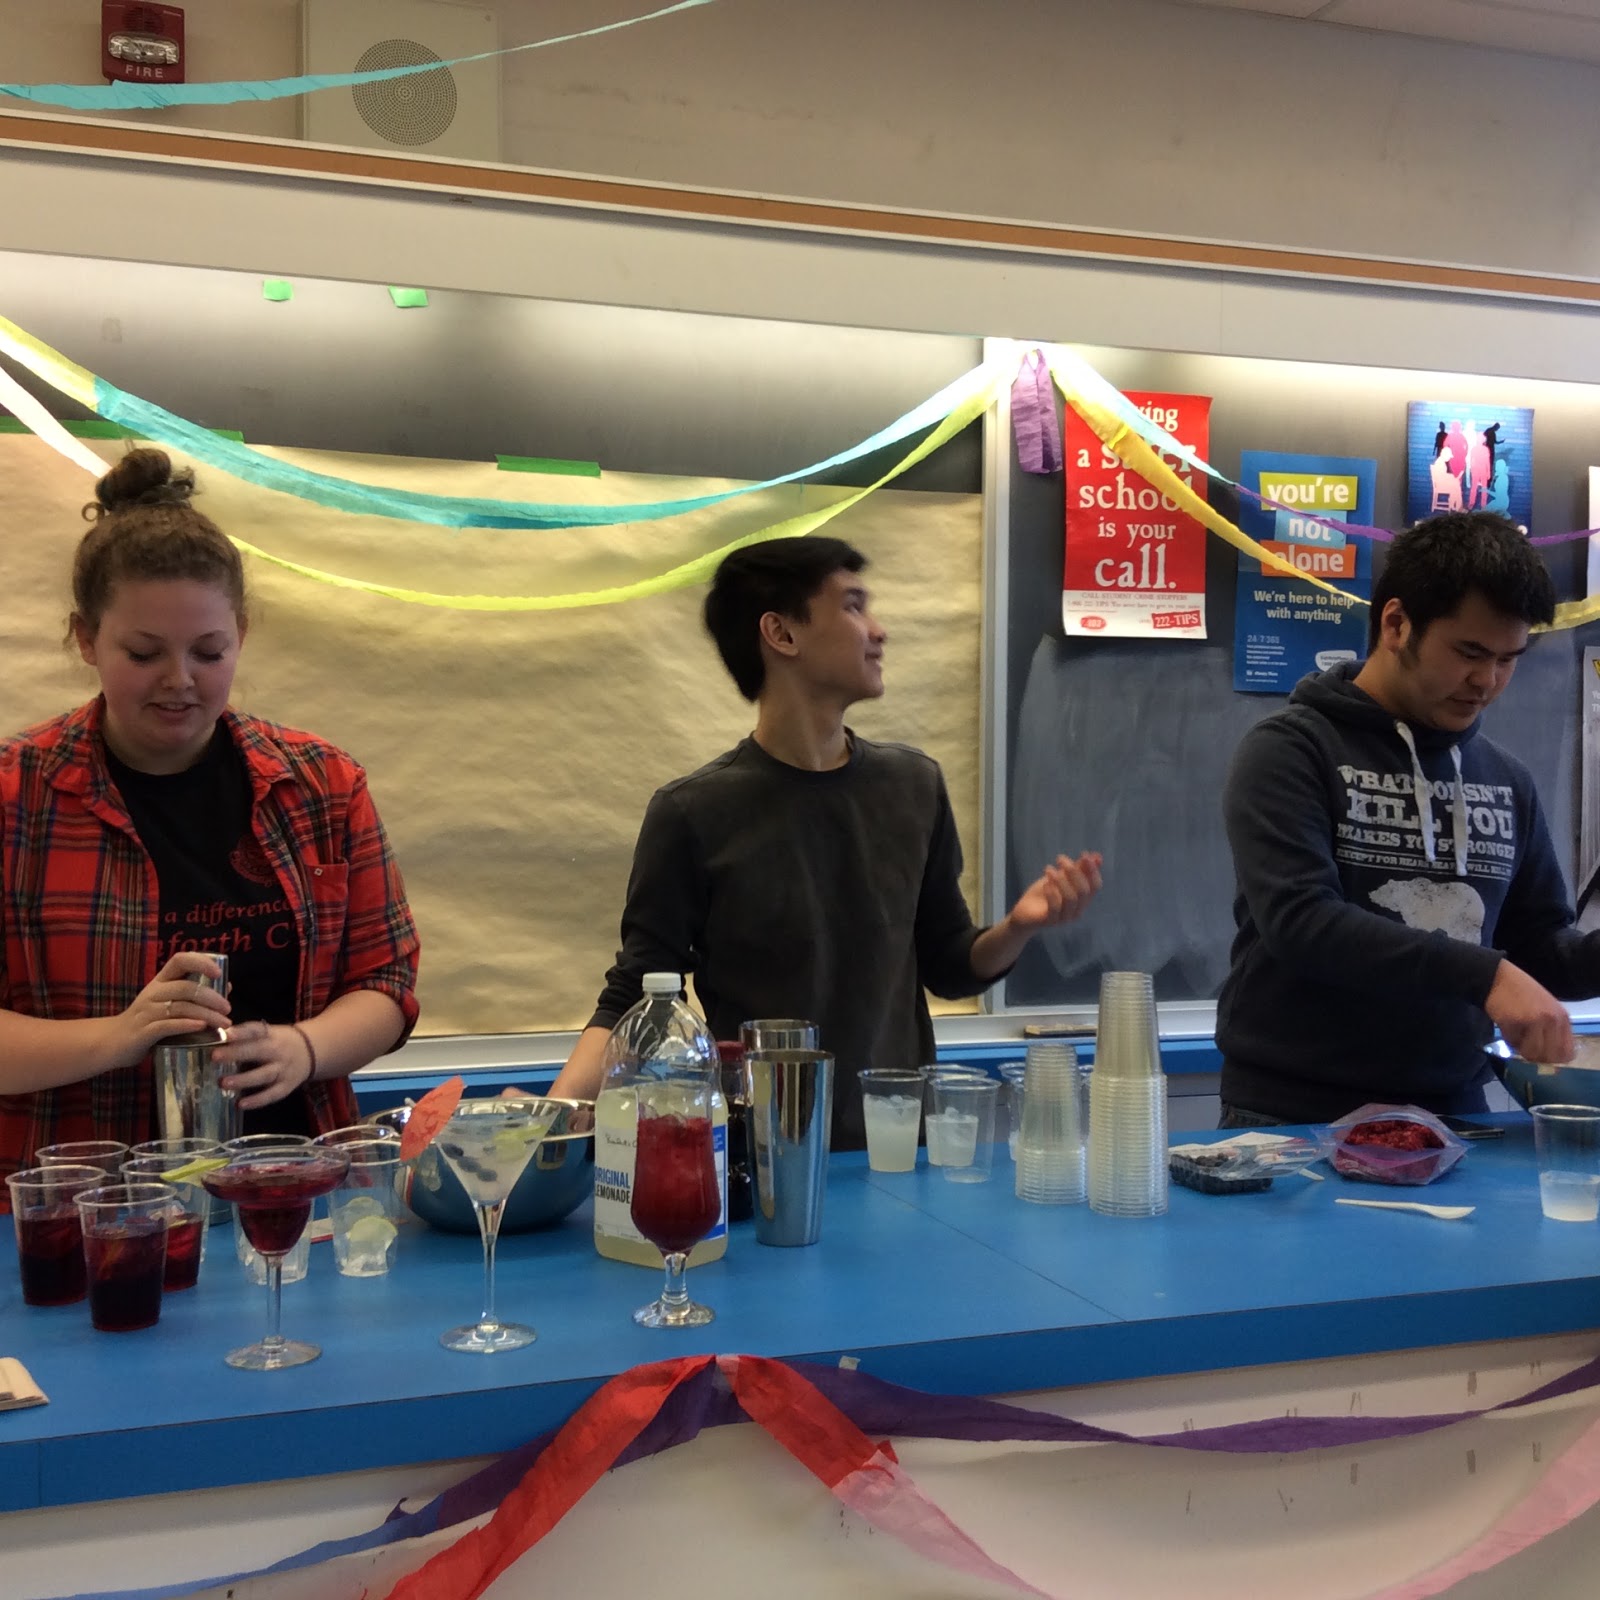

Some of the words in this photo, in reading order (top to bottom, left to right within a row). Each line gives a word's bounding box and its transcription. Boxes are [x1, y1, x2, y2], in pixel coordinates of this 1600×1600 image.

[125, 64, 164, 78] FIRE
[1076, 448, 1091, 468] a
[1079, 472, 1192, 511] schoo
[1267, 476, 1349, 510] you're
[1098, 516, 1116, 538] is
[1126, 523, 1177, 548] your
[1094, 542, 1177, 589] call.
[1253, 590, 1286, 603] We're
[1289, 590, 1313, 604] here
[1316, 592, 1327, 605] to
[1154, 613, 1199, 628] 222-TIPS
[1266, 607, 1292, 620] with
[1294, 608, 1342, 625] anything
[1336, 822, 1401, 848] MAKES
[1404, 833, 1436, 850] YO
[1376, 854, 1398, 865] FOR
[1467, 862, 1491, 873] WILL
[164, 911, 177, 923] a
